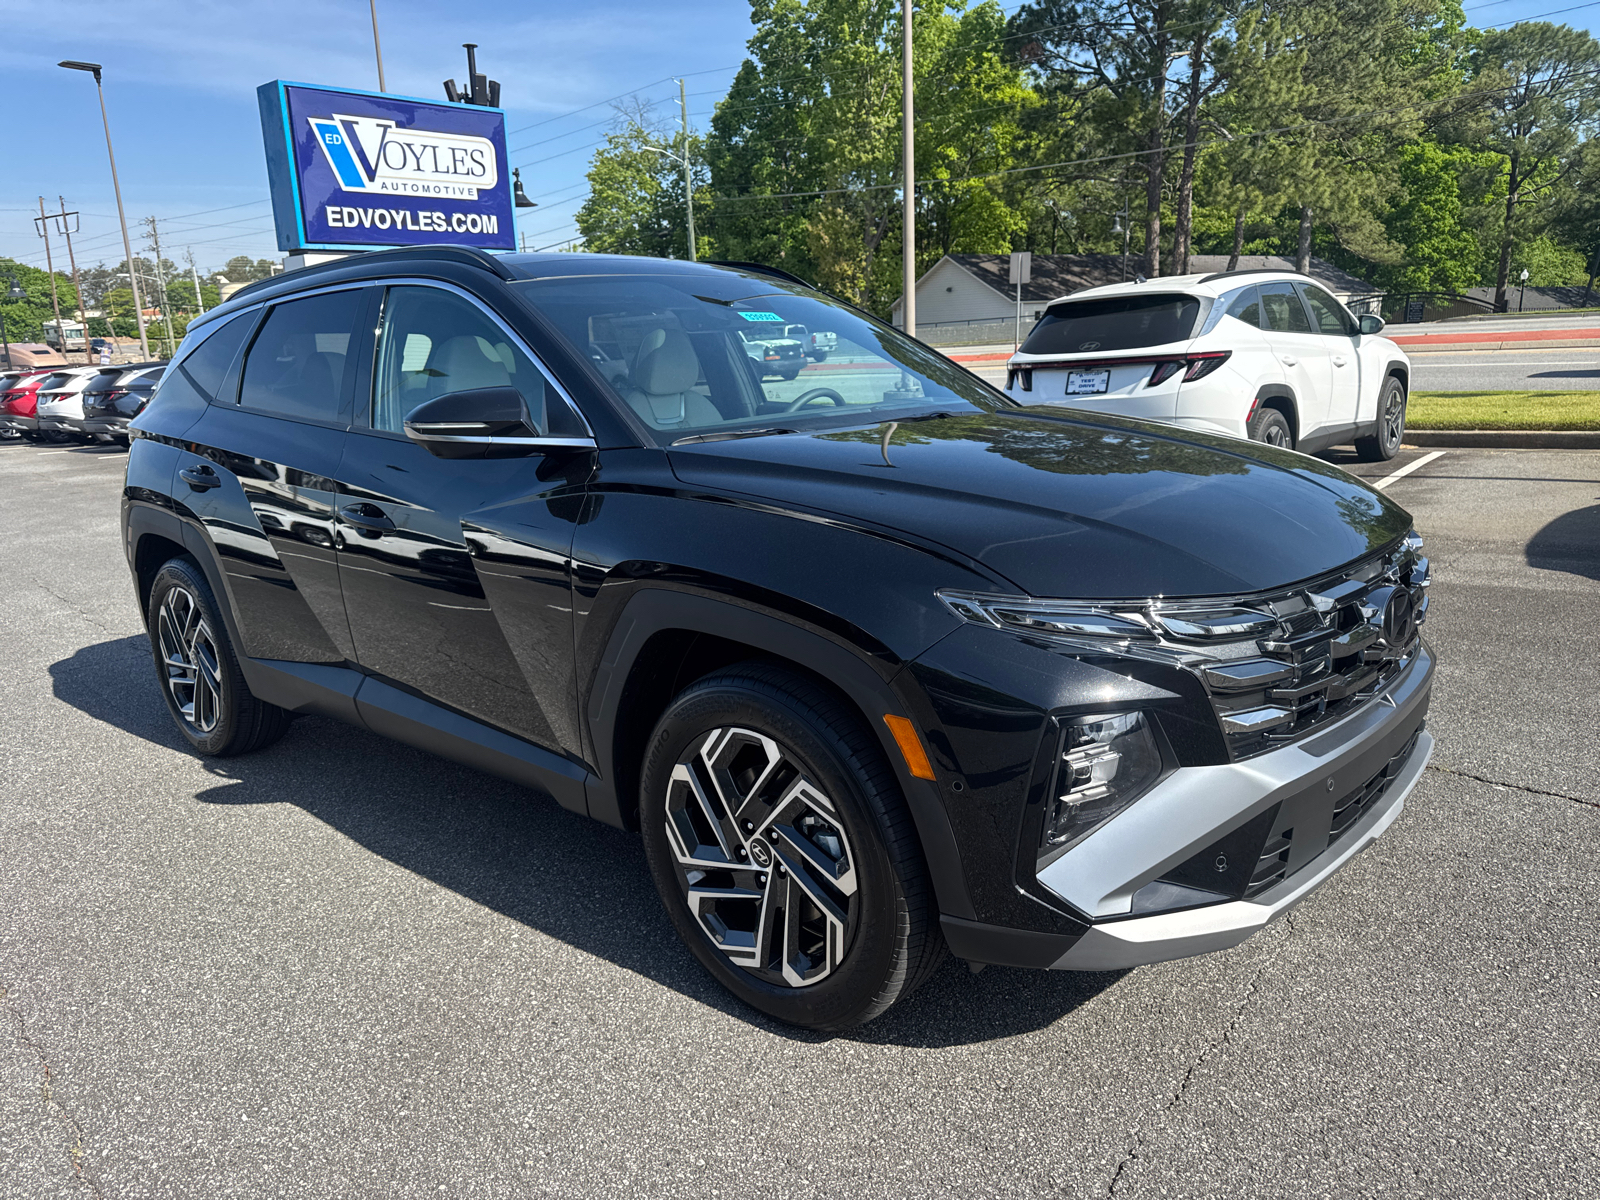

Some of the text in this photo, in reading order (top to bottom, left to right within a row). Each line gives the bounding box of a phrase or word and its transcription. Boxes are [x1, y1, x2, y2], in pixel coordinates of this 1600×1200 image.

[325, 119, 486, 182] ED VOYLES
[381, 182, 475, 196] AUTOMOTIVE
[325, 205, 498, 234] EDVOYLES.COM
[643, 729, 670, 794] KUMHO
